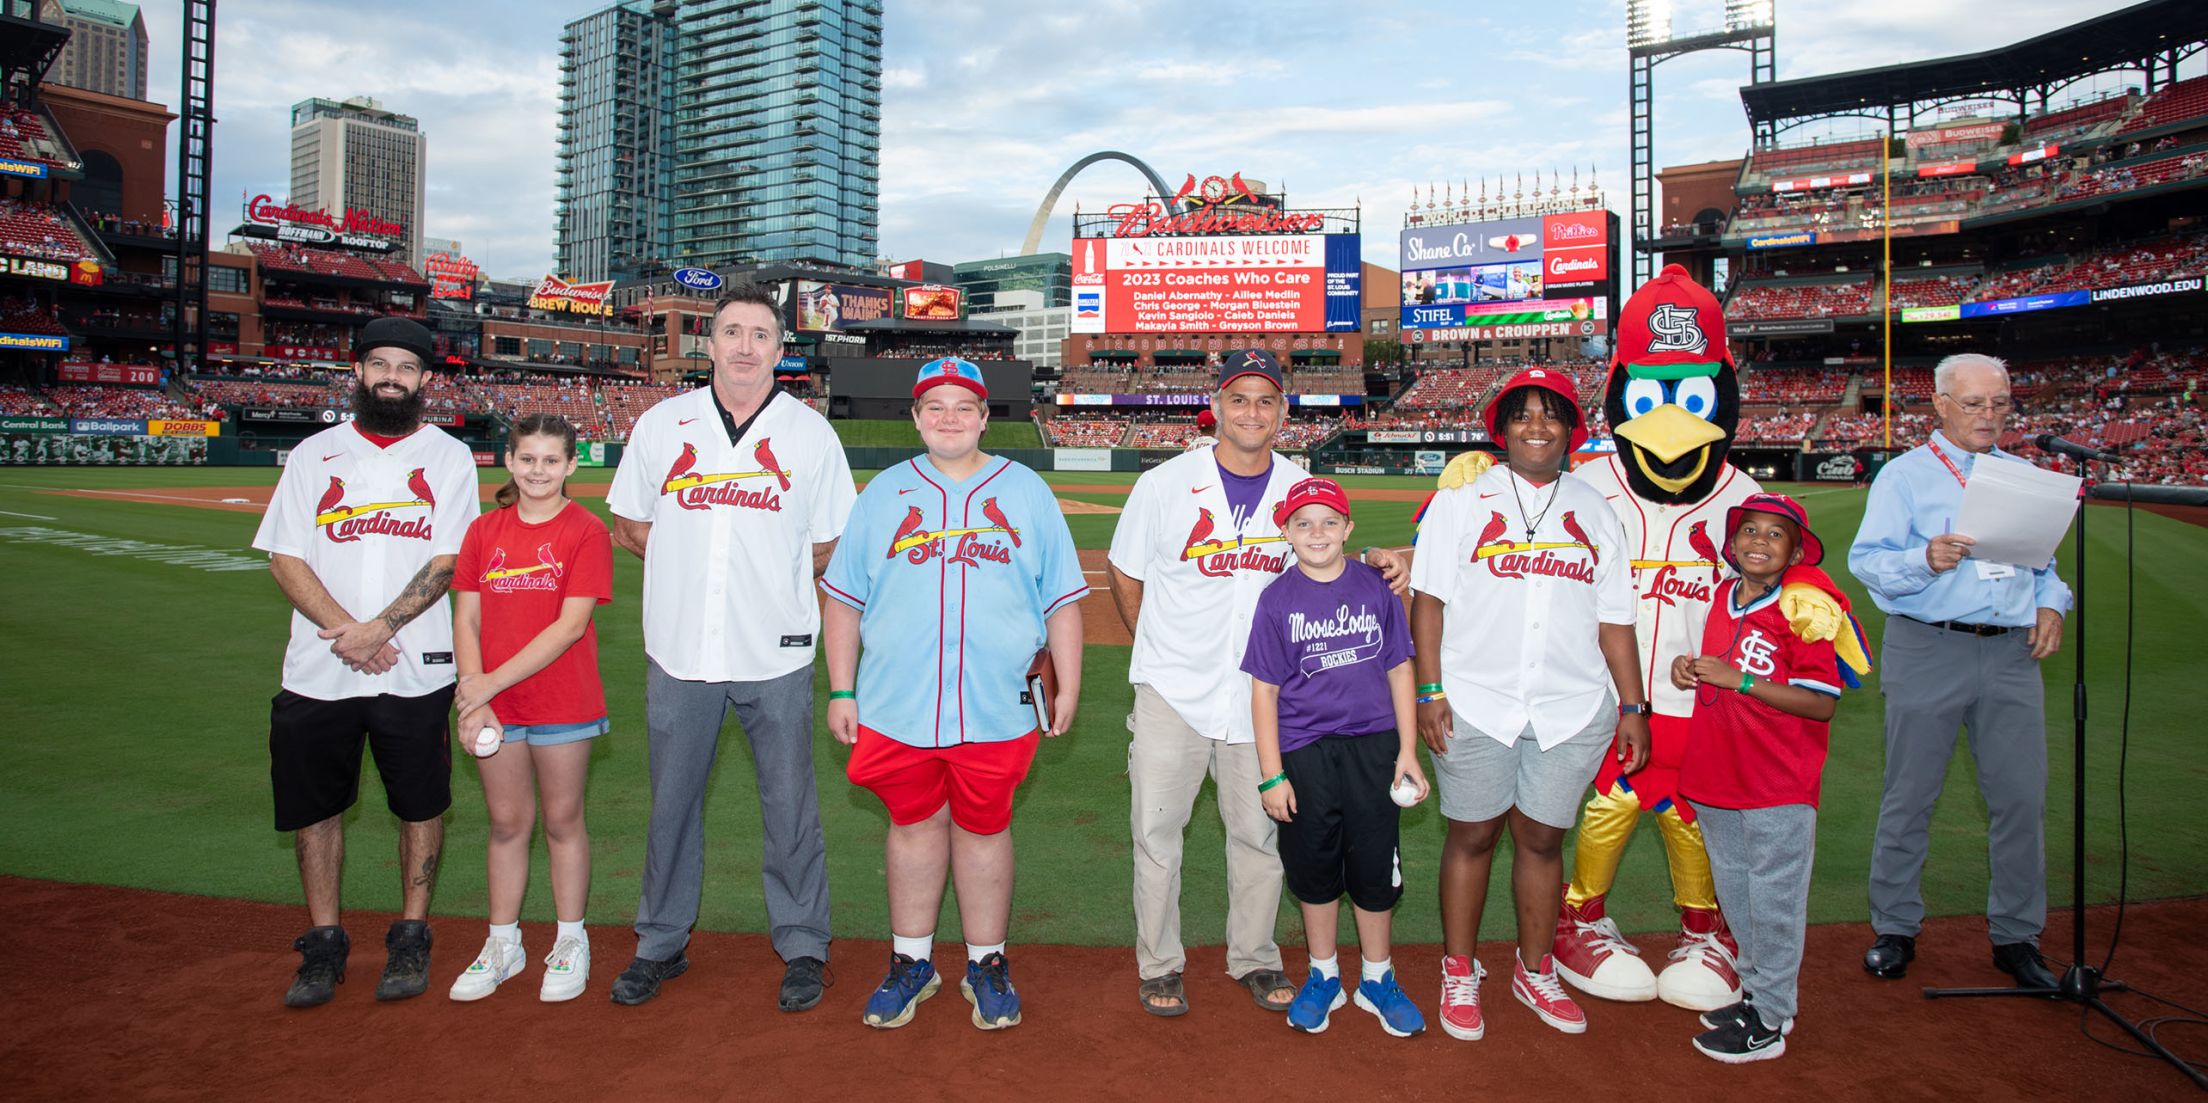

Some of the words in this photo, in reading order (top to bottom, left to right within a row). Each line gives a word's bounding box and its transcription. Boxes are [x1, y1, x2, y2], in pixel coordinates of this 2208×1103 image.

[1945, 125, 2003, 138] BUDWEISER
[249, 194, 333, 228] Cardinals
[334, 207, 402, 236] Nation
[1484, 199, 1584, 216] CHAMPIONS
[1108, 203, 1325, 238] Budweiser
[278, 226, 327, 241] HOFFMANN
[1551, 222, 1599, 241] Phillies
[341, 235, 389, 250] ROOFTOP
[1157, 240, 1236, 257] CARDINALS
[1242, 239, 1311, 256] WELCOME
[1408, 236, 1452, 261] Shane
[10, 258, 69, 280] LAND
[425, 252, 480, 281] Bally
[984, 262, 1017, 272] POLSINELLI
[1550, 256, 1599, 275] Cardinals
[684, 271, 714, 287] Ford
[1122, 274, 1161, 286] 2023
[1165, 273, 1230, 286] Coaches
[1233, 272, 1270, 285] Who
[1274, 272, 1311, 285] Care
[535, 279, 613, 301] Budweiser
[1133, 291, 1166, 301] Daniel
[1169, 290, 1223, 302] Abernathy
[1265, 290, 1301, 300] Medlin
[2092, 279, 2202, 301] LINDENWOOD.EDU
[530, 296, 567, 312] BREW
[569, 299, 613, 317] HOUSE
[841, 293, 888, 312] THANKS
[1133, 301, 1160, 311] Chris
[1162, 301, 1201, 311] George
[1210, 301, 1249, 311] Morgan
[1252, 300, 1301, 310] Bluestein
[841, 306, 882, 321] WAINO
[1138, 311, 1167, 321] Kevin
[1224, 310, 1255, 320] Caleb
[1257, 310, 1296, 320] Daniels
[1413, 308, 1454, 324] STIFEL
[1135, 321, 1177, 332] Makayla
[1179, 321, 1210, 330] Smith
[1219, 320, 1262, 332] Greyson
[1264, 320, 1298, 330] Brown
[1432, 328, 1480, 342] BROWN
[1483, 330, 1492, 339] &
[1495, 323, 1570, 339] CROUPPEN
[130, 371, 154, 383] 200
[1146, 395, 1163, 405] ST.
[1167, 395, 1199, 405] LOUIS
[2, 420, 39, 430] Central
[41, 421, 68, 430] Bank
[91, 421, 140, 432] Ballpark
[164, 422, 206, 431] DOBBS
[422, 415, 453, 423] PURINA
[1438, 431, 1455, 441] 5:51
[1356, 467, 1385, 475] STADIUM
[677, 472, 782, 513] Cardinals
[326, 505, 433, 543] Cardinals
[908, 531, 943, 565] St.
[947, 532, 1011, 569] Louis
[1197, 539, 1289, 577] Cardinal
[1487, 540, 1595, 585] Cardinals
[490, 568, 558, 593] Cardinals
[1641, 564, 1711, 607] Louis
[1306, 642, 1328, 653] #1221
[1321, 650, 1358, 668] ROCKIES
